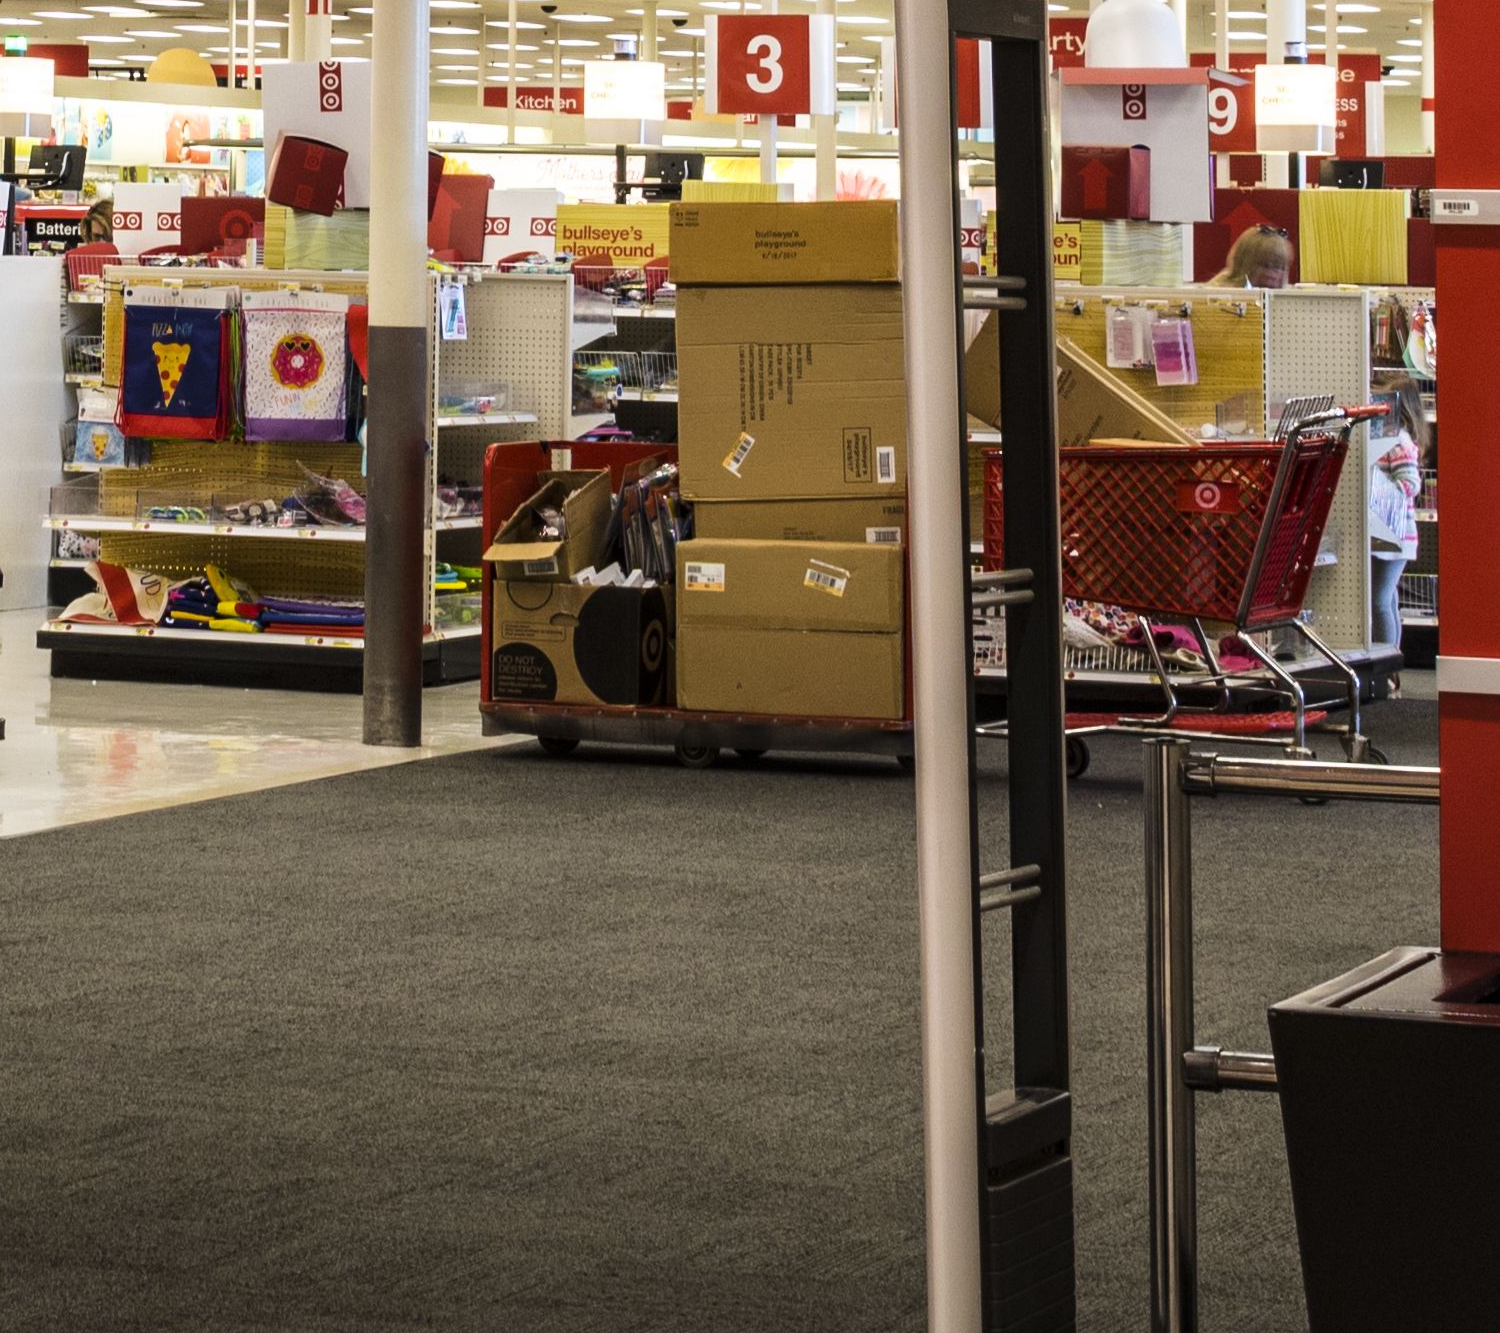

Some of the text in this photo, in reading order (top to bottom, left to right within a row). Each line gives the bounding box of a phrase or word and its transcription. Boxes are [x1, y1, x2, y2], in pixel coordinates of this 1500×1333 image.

[1050, 32, 1086, 55] rty
[745, 35, 784, 94] 3
[515, 95, 577, 110] Kitchen
[1208, 88, 1238, 135] 9
[36, 222, 81, 235] Batteri
[563, 225, 643, 243] bullseye's
[562, 242, 655, 257] playground
[755, 240, 807, 250] playground
[515, 655, 535, 665] NOT
[498, 664, 543, 674] DESTROY
